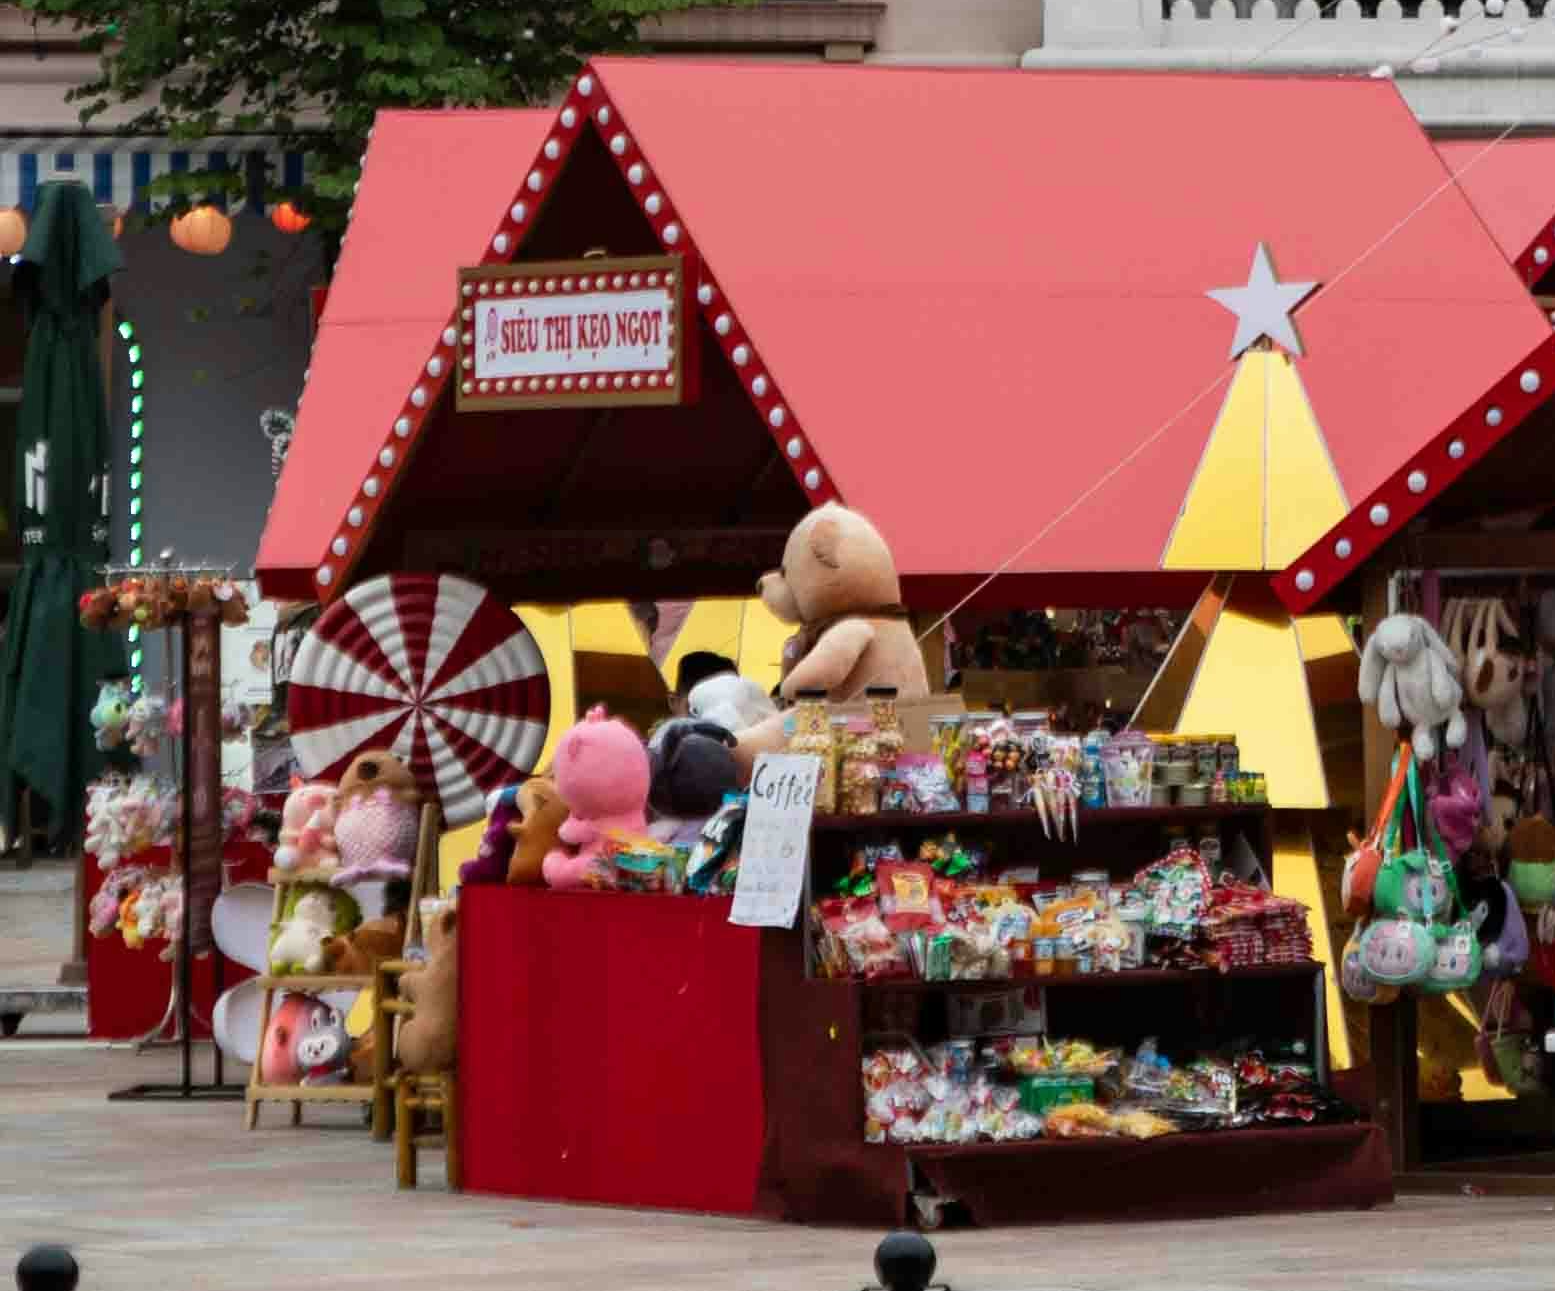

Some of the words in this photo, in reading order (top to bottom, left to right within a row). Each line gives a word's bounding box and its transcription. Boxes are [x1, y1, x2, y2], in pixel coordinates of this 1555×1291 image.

[500, 308, 540, 355] SIÊU
[543, 314, 573, 359] THỊ
[576, 312, 611, 359] KẸO
[615, 310, 663, 356] NGỌT
